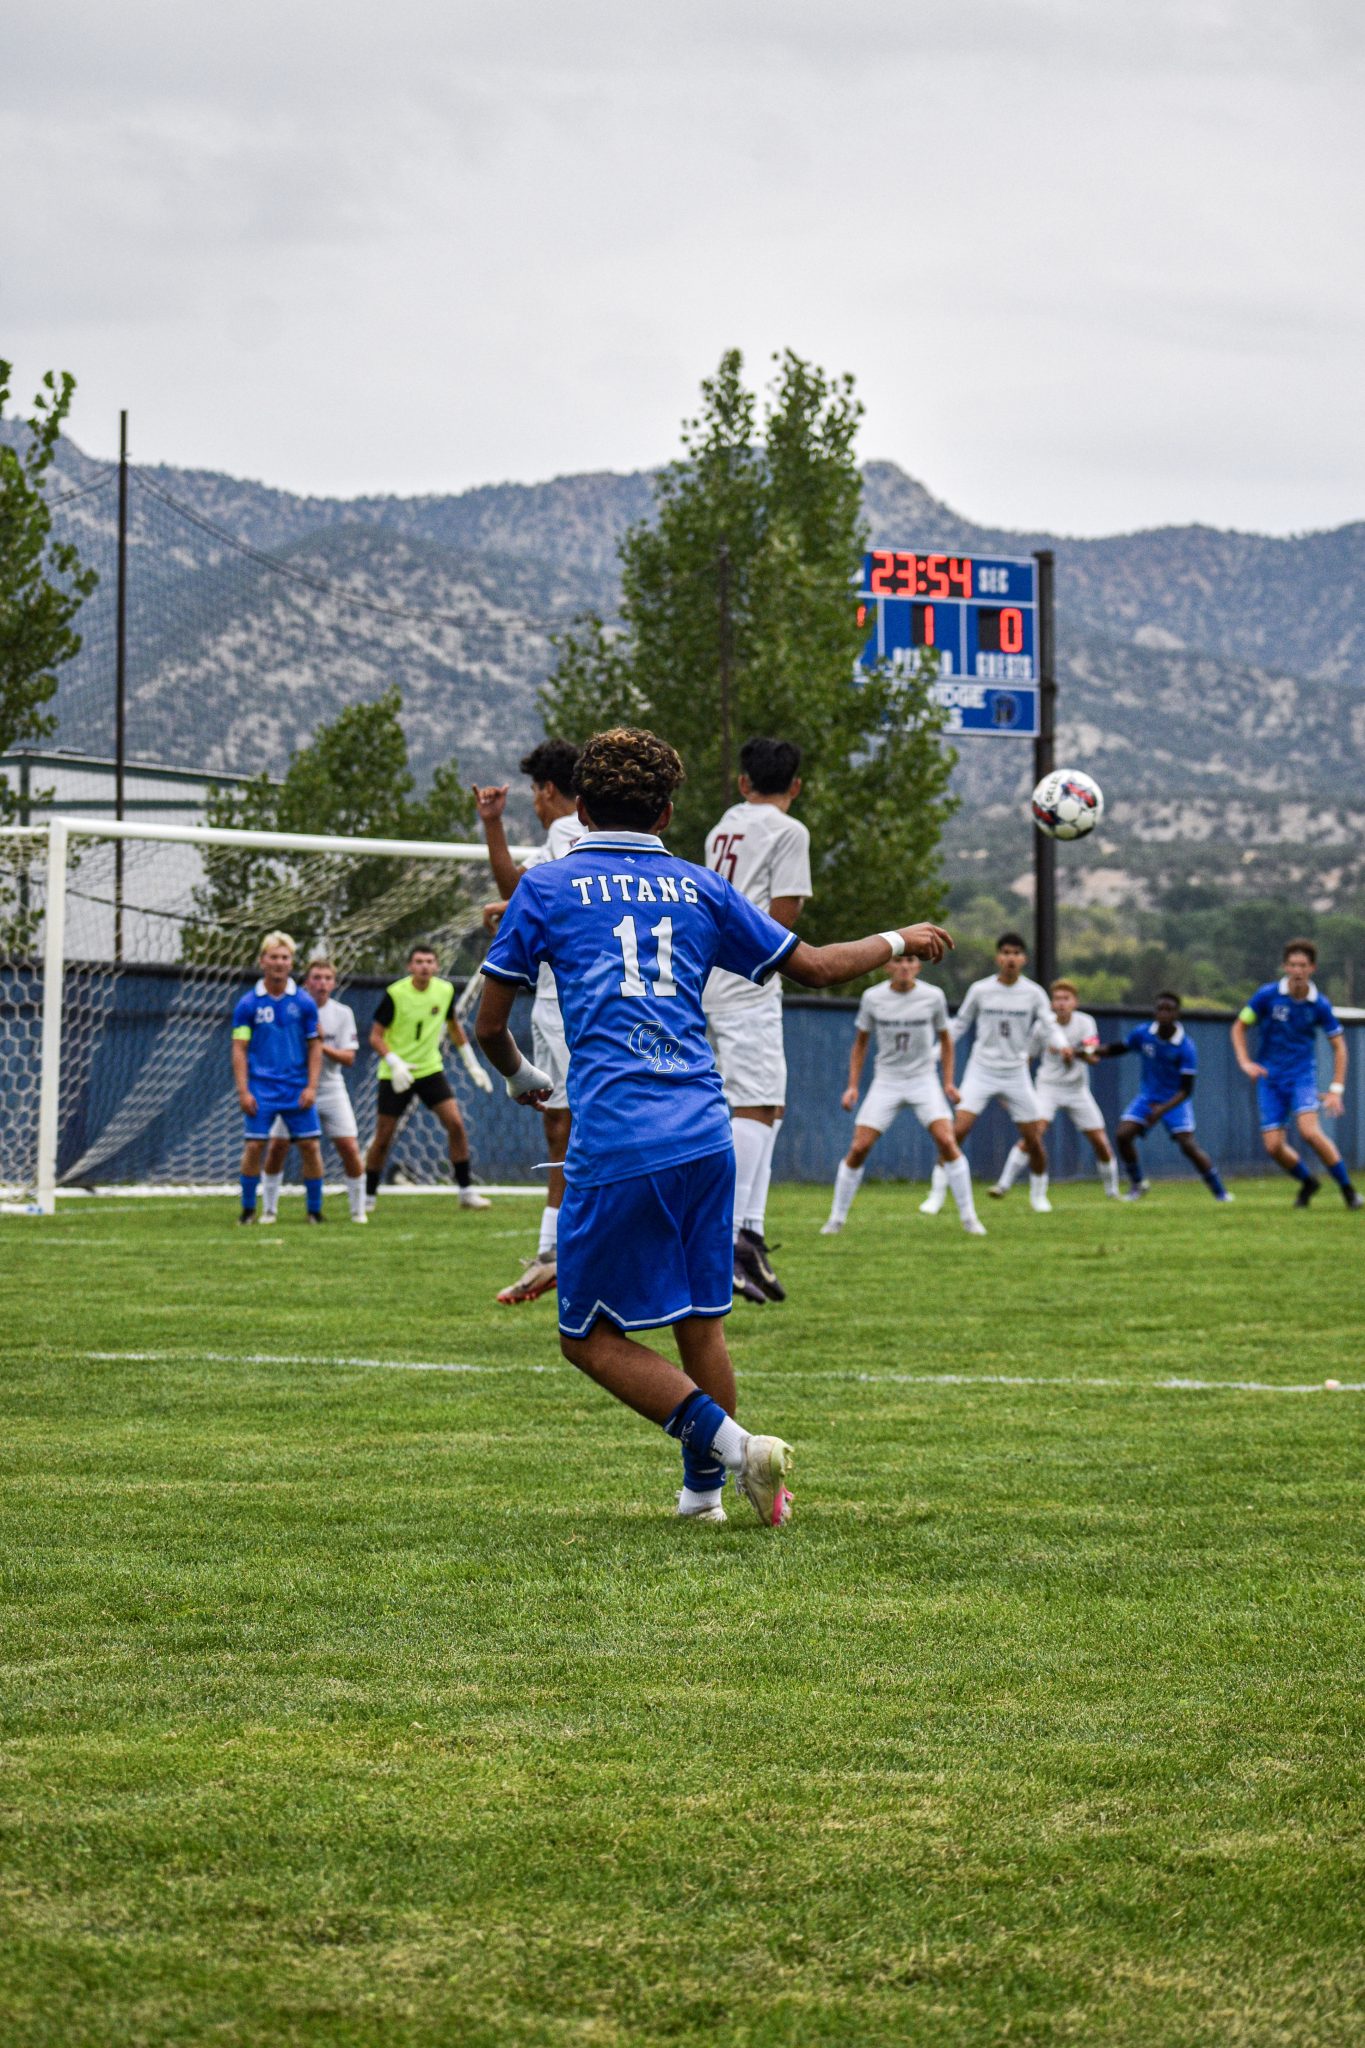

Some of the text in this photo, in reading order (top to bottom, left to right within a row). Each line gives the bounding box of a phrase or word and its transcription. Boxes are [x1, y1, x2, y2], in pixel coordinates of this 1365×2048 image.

[871, 550, 973, 599] 23:54
[924, 605, 935, 646] 1
[1000, 608, 1023, 654] 0
[892, 647, 953, 676] PERD
[571, 874, 700, 905] TITANS
[612, 915, 678, 997] 11
